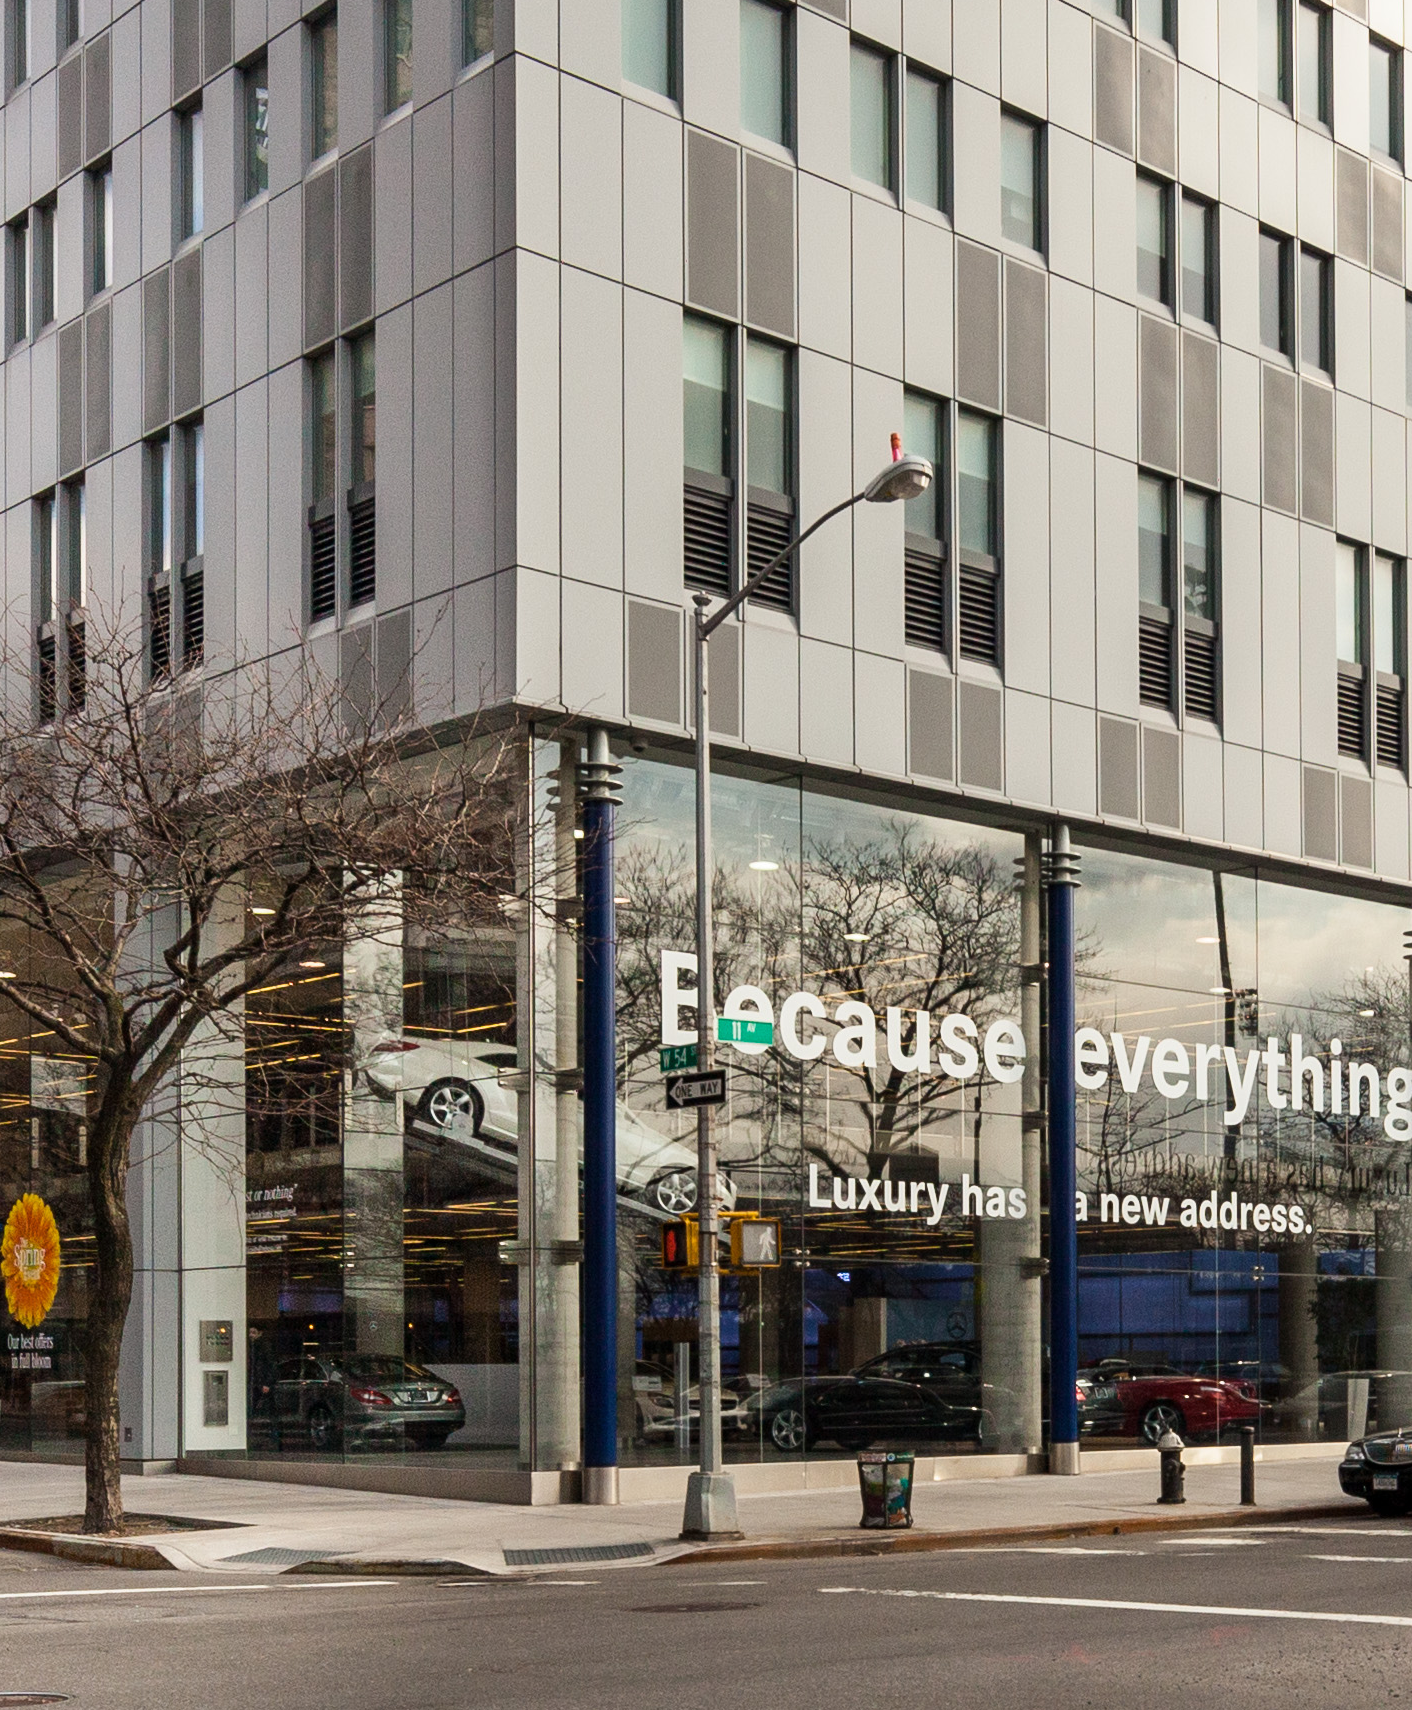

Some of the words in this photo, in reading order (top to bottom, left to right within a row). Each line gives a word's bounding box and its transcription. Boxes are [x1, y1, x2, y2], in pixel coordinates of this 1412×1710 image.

[661, 950, 1027, 1083] Because
[732, 1021, 742, 1040] 11
[747, 1022, 757, 1033] AV
[662, 1050, 671, 1069] W
[674, 1047, 687, 1068] 54
[675, 1083, 693, 1097] ONE
[699, 1081, 719, 1095] WAY
[809, 1163, 950, 1226] Luxury
[962, 1173, 1027, 1219] has
[1075, 1190, 1088, 1222] a
[1100, 1193, 1170, 1226] new
[1180, 1190, 1313, 1235] address.
[13, 1244, 46, 1272] Spring
[7, 1333, 20, 1350] Our
[21, 1333, 34, 1349] best
[35, 1332, 54, 1349] offers
[11, 1353, 19, 1369] in
[20, 1352, 31, 1369] full
[32, 1352, 52, 1369] bloom
